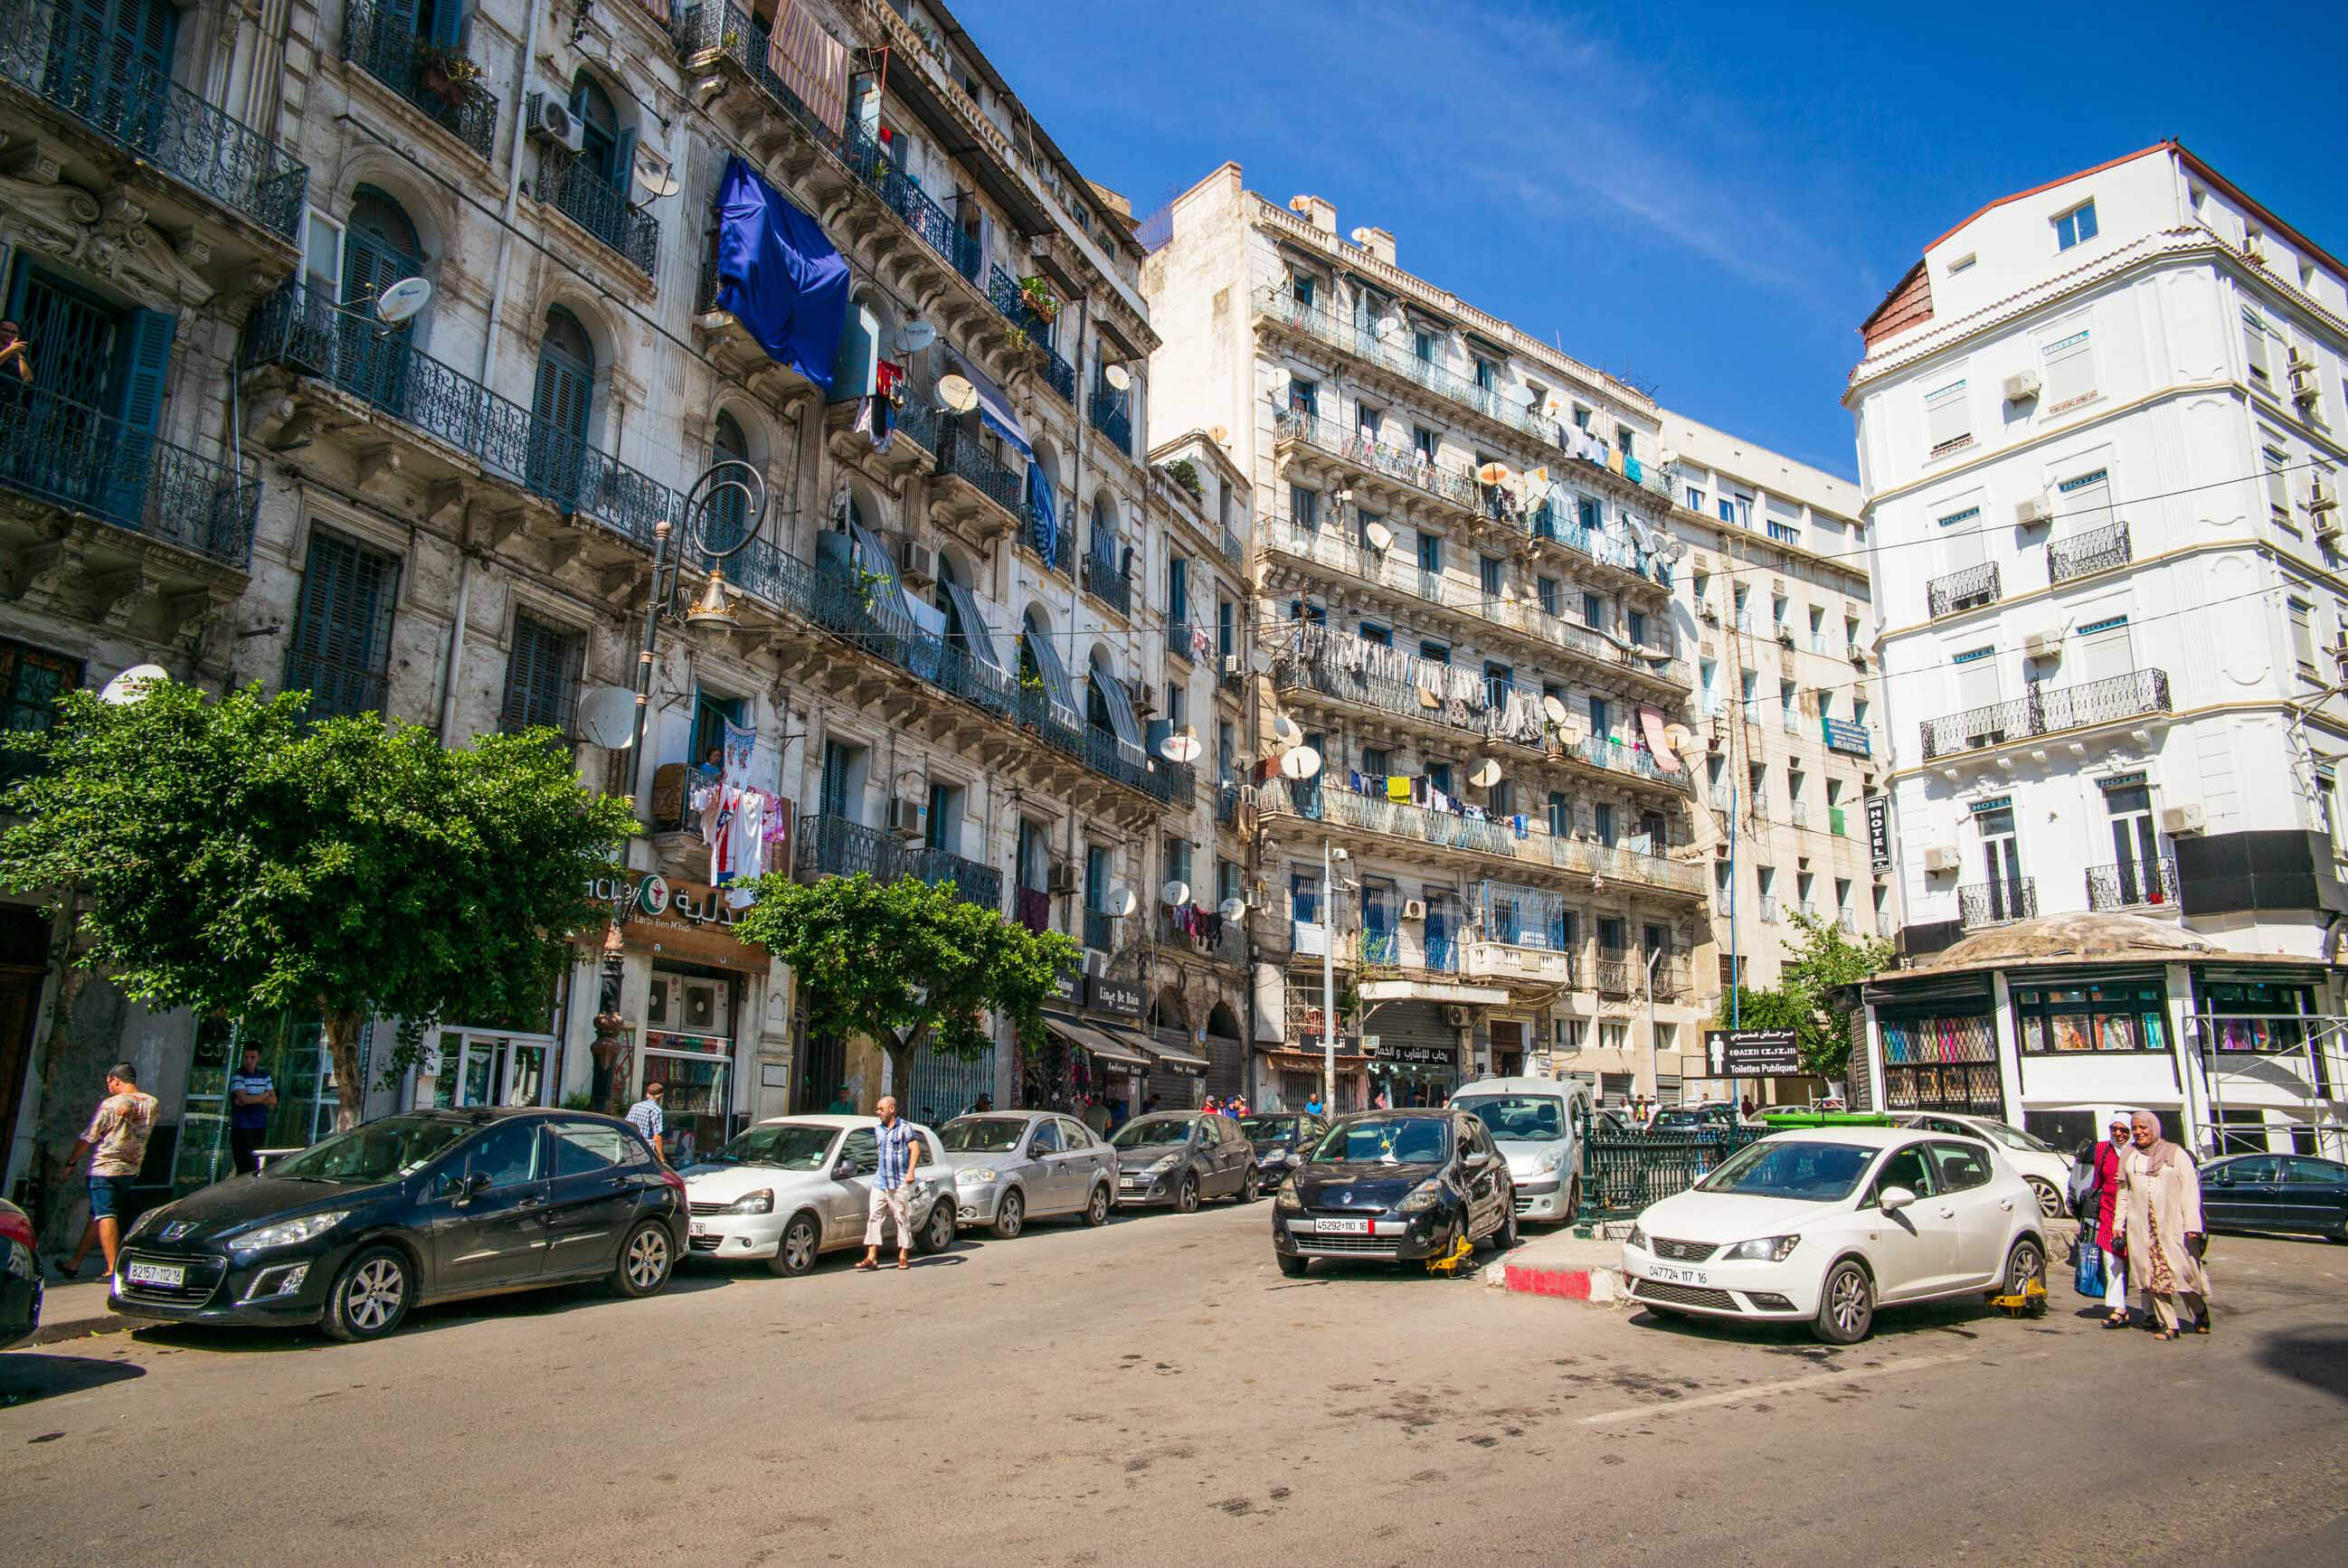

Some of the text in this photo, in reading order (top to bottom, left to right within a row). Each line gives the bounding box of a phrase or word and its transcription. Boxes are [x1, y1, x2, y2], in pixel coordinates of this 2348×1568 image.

[1870, 809, 1884, 855] HOTEL
[655, 918, 670, 930] Ben
[1099, 987, 1115, 1007] Linge
[1117, 990, 1125, 1003] De
[1396, 1048, 1401, 1060] و
[1730, 1063, 1798, 1074] Toilettes Publiques
[1359, 1222, 1368, 1231] 16
[174, 1270, 182, 1282] 16
[1649, 1265, 1707, 1284] 047724 117 16
